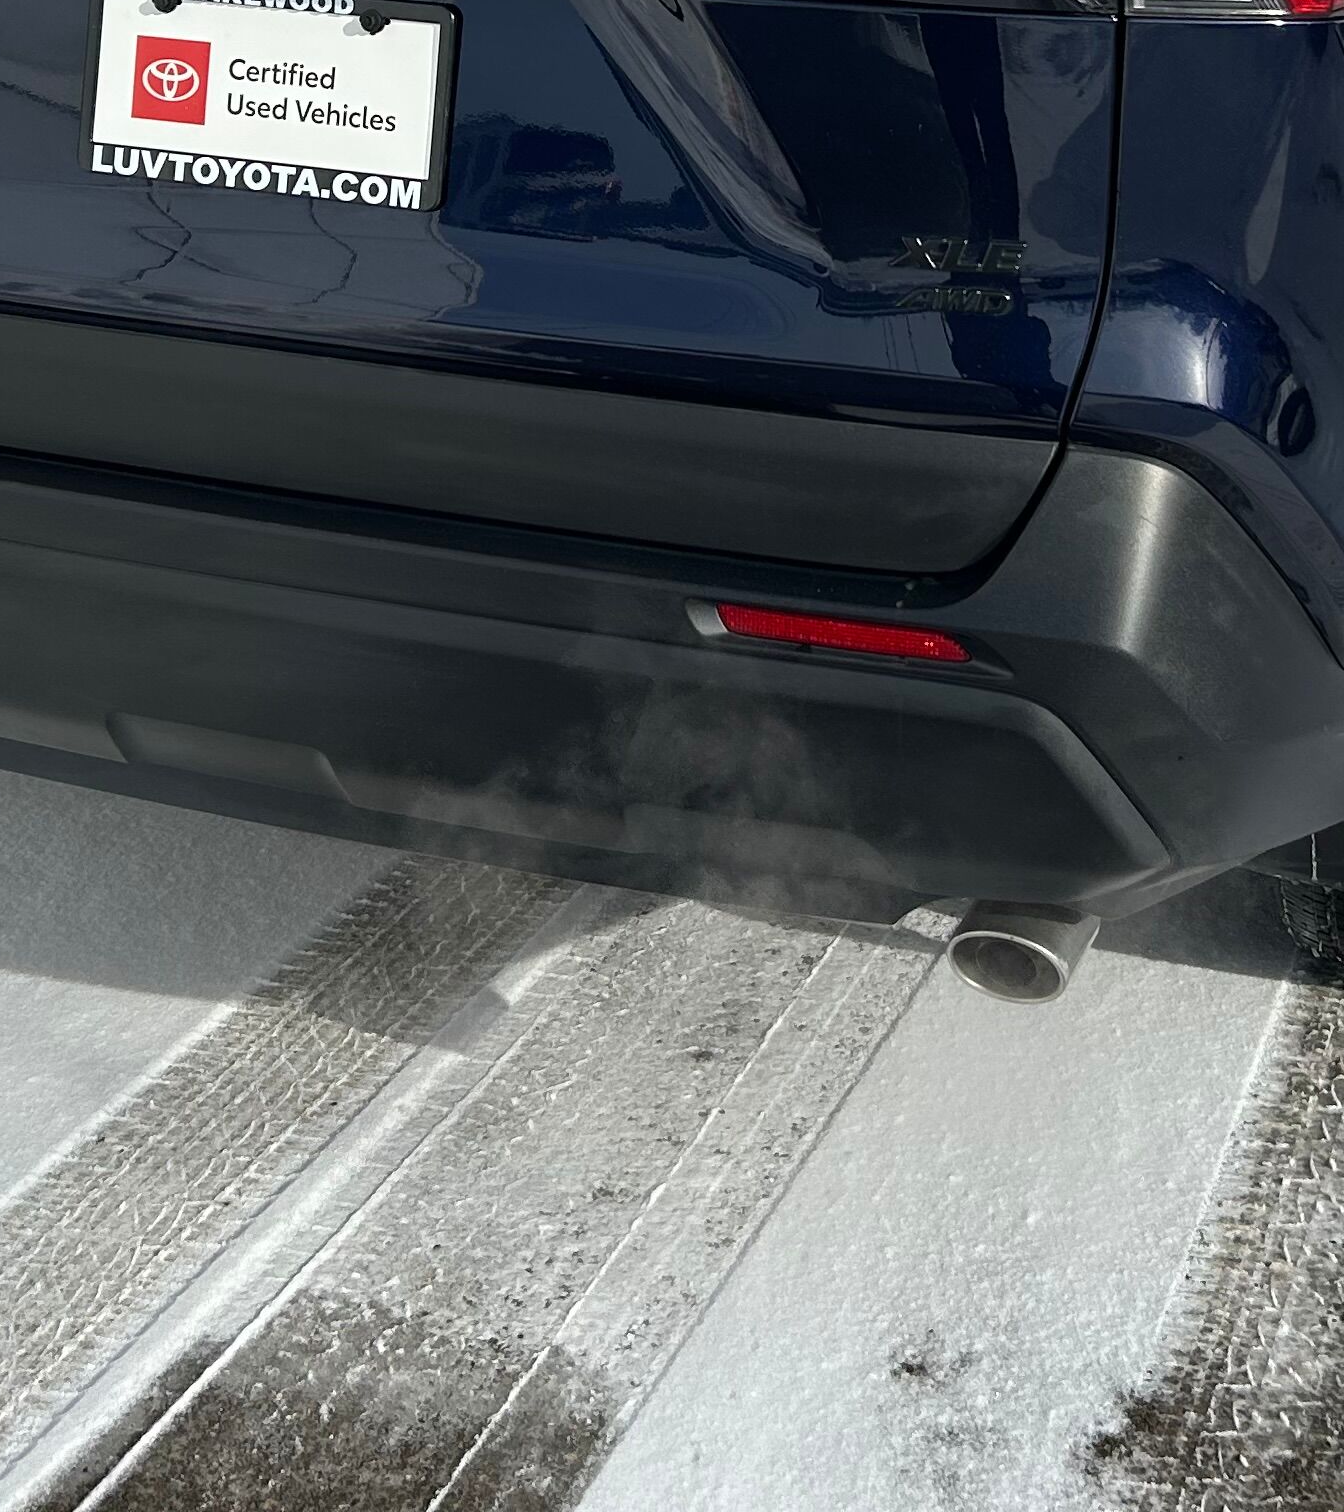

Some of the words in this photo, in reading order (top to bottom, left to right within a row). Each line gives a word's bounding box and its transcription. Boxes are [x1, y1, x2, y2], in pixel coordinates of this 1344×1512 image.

[229, 58, 336, 90] Certified
[227, 93, 287, 121] Used
[295, 100, 397, 132] Vehicles
[91, 144, 423, 210] LUVTOYOTA.COM
[888, 236, 1028, 272] XLE
[896, 287, 1014, 316] AWD
